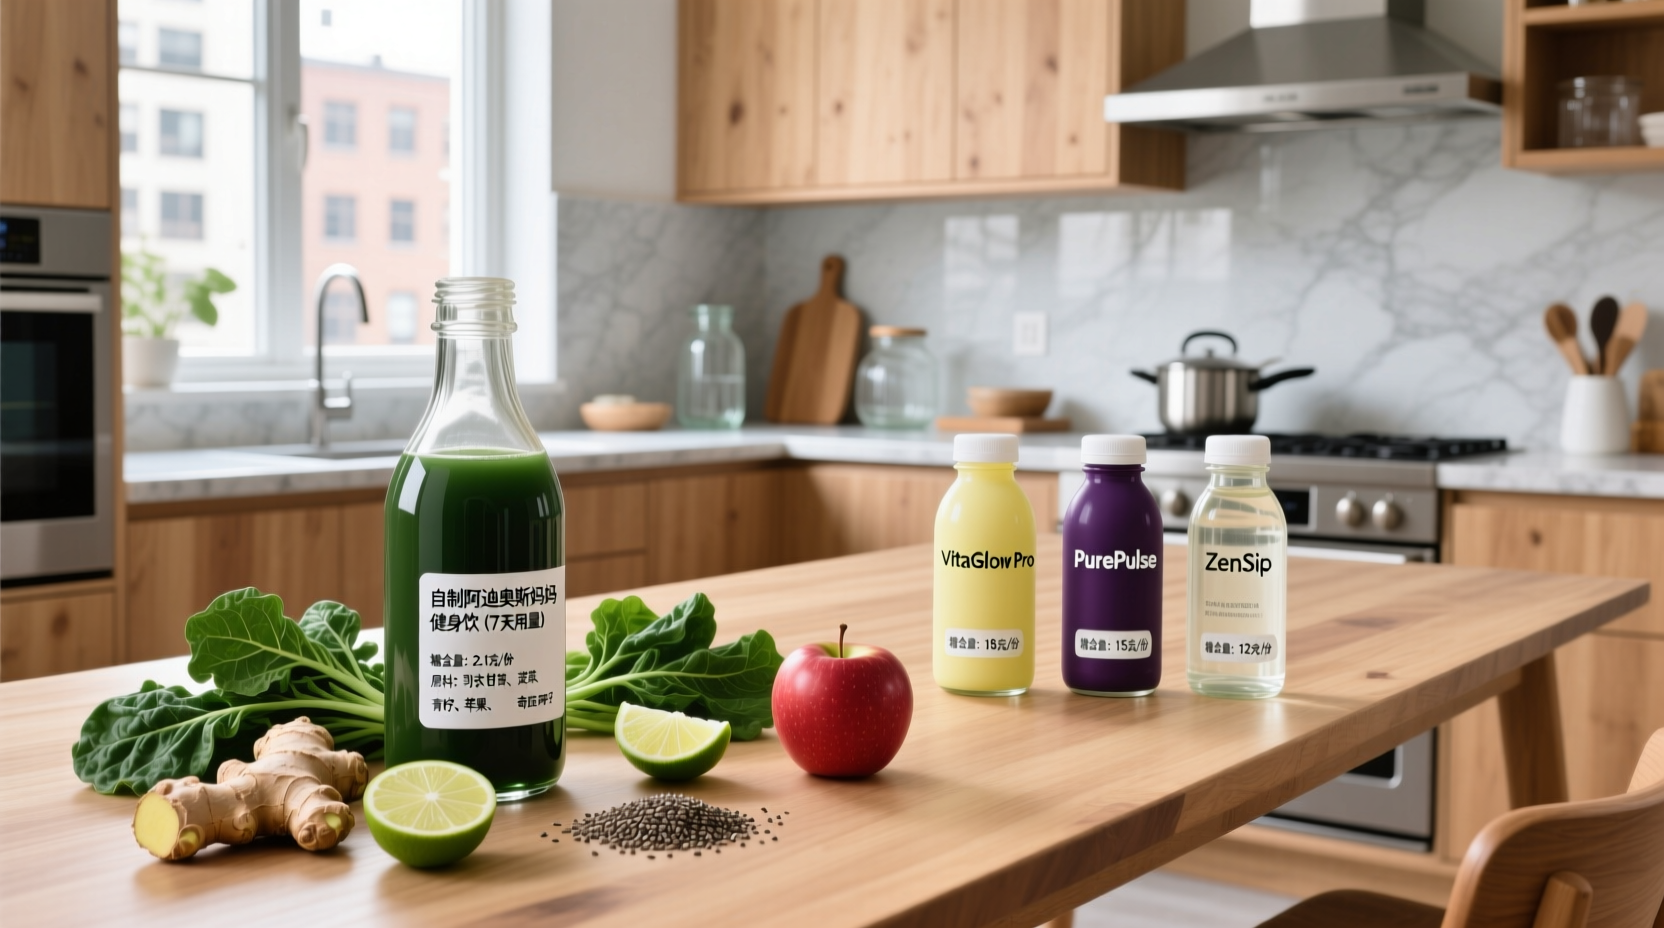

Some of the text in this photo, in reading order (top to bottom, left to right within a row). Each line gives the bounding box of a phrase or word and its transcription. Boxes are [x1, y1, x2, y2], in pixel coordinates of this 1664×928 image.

[941, 550, 1035, 569] VitaGlow Pro
[1074, 549, 1157, 570] PurePulse
[1205, 552, 1272, 577] ZenSip
